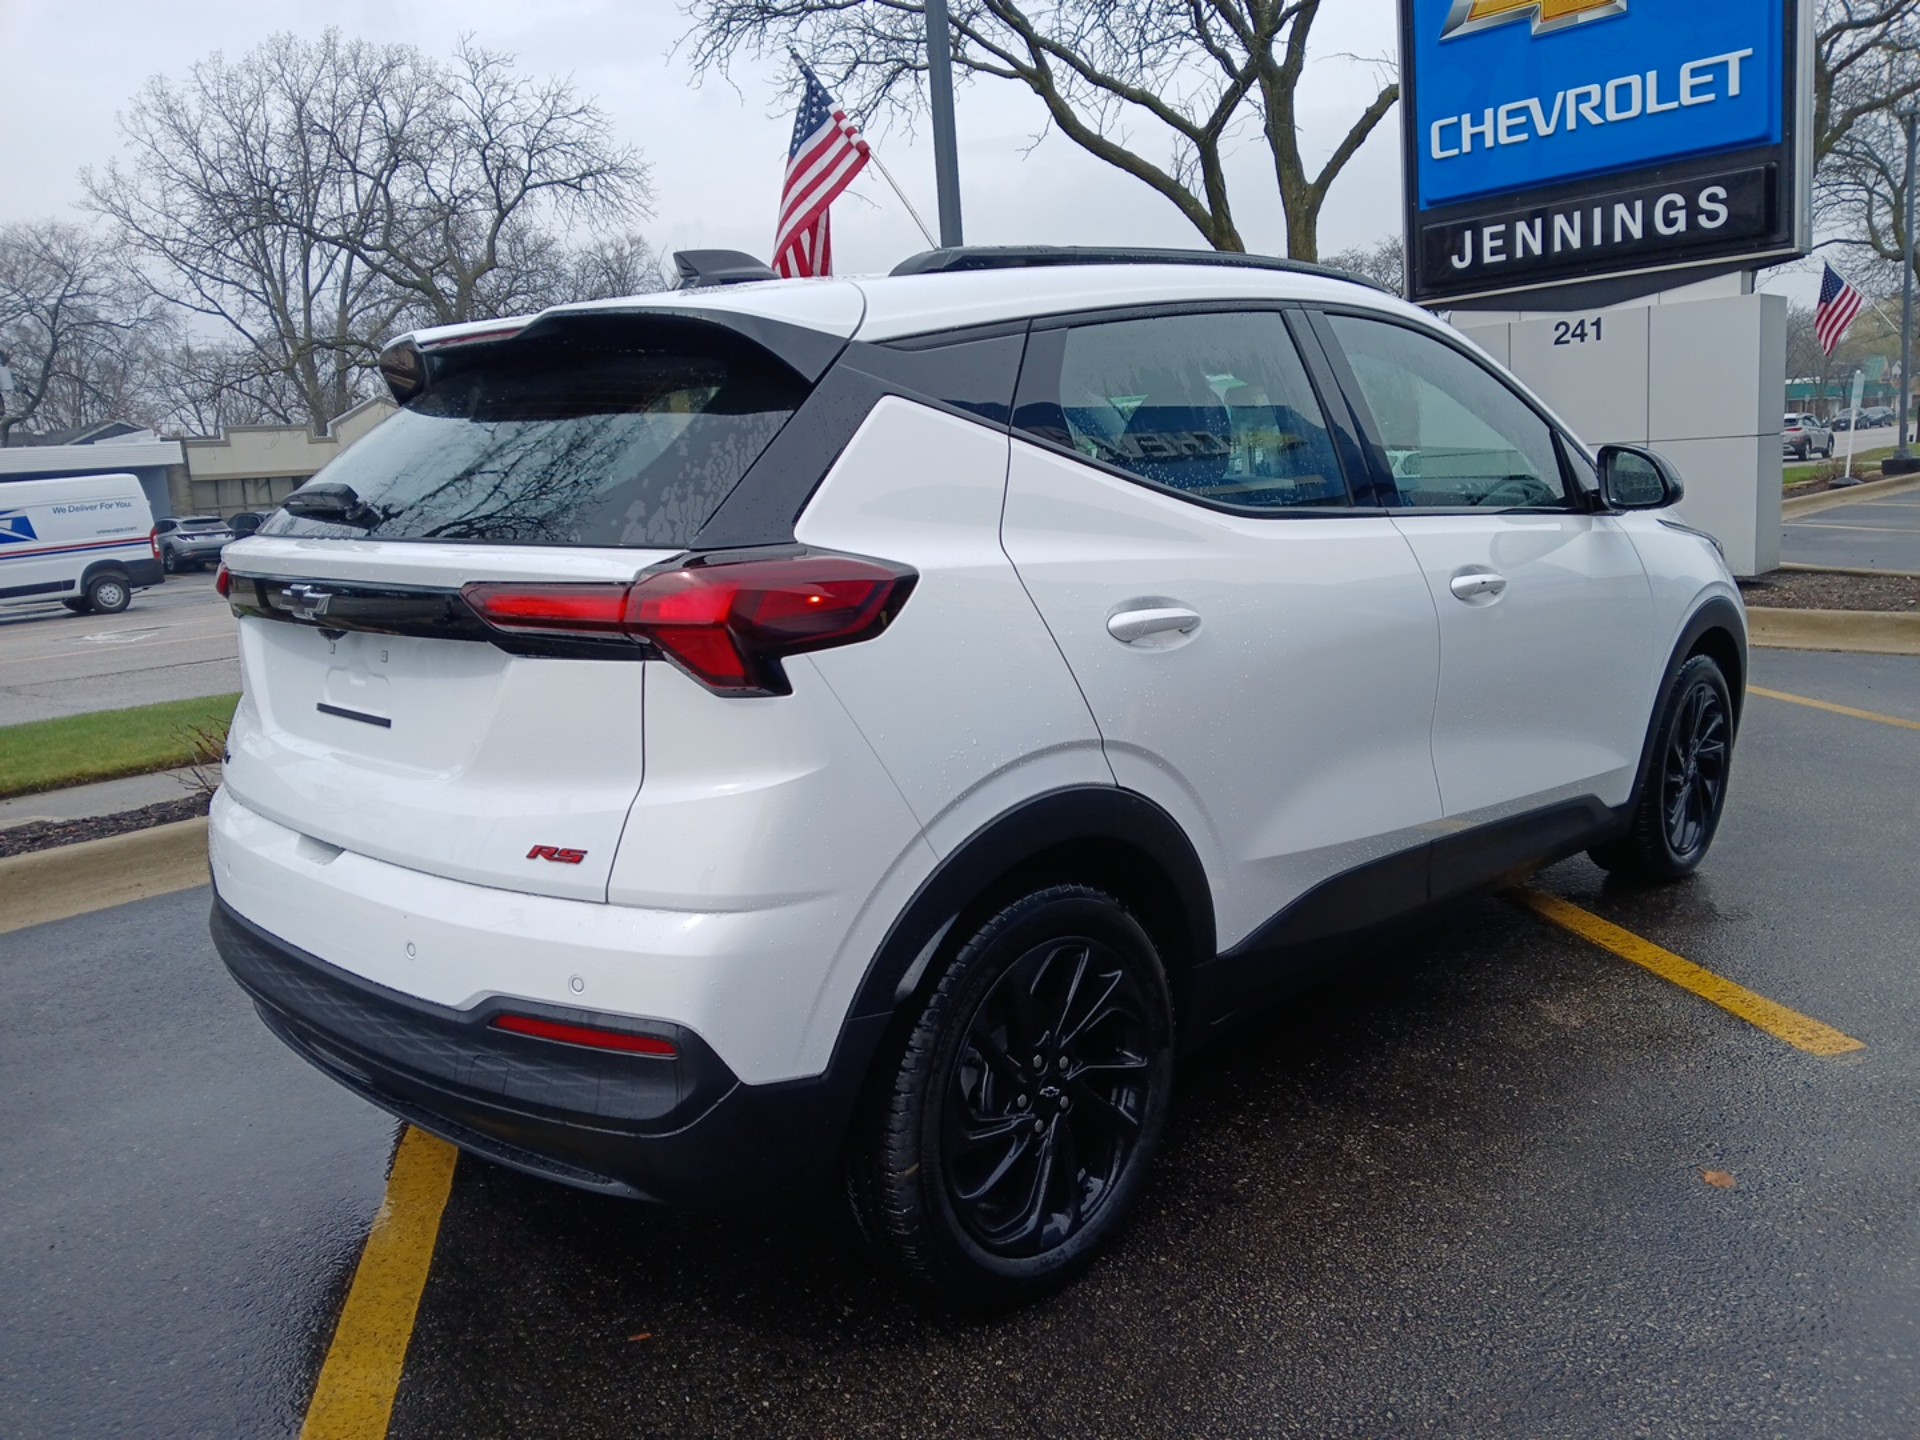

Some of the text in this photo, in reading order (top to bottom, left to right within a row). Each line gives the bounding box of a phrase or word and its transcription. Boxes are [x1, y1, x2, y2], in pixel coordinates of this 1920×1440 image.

[1430, 47, 1753, 160] CHEVROLET
[1451, 185, 1729, 269] JENNINGS
[1553, 317, 1603, 346] 241
[52, 506, 66, 514] We
[68, 504, 98, 512] Deliver
[100, 502, 114, 510] For
[526, 844, 588, 864] RS
